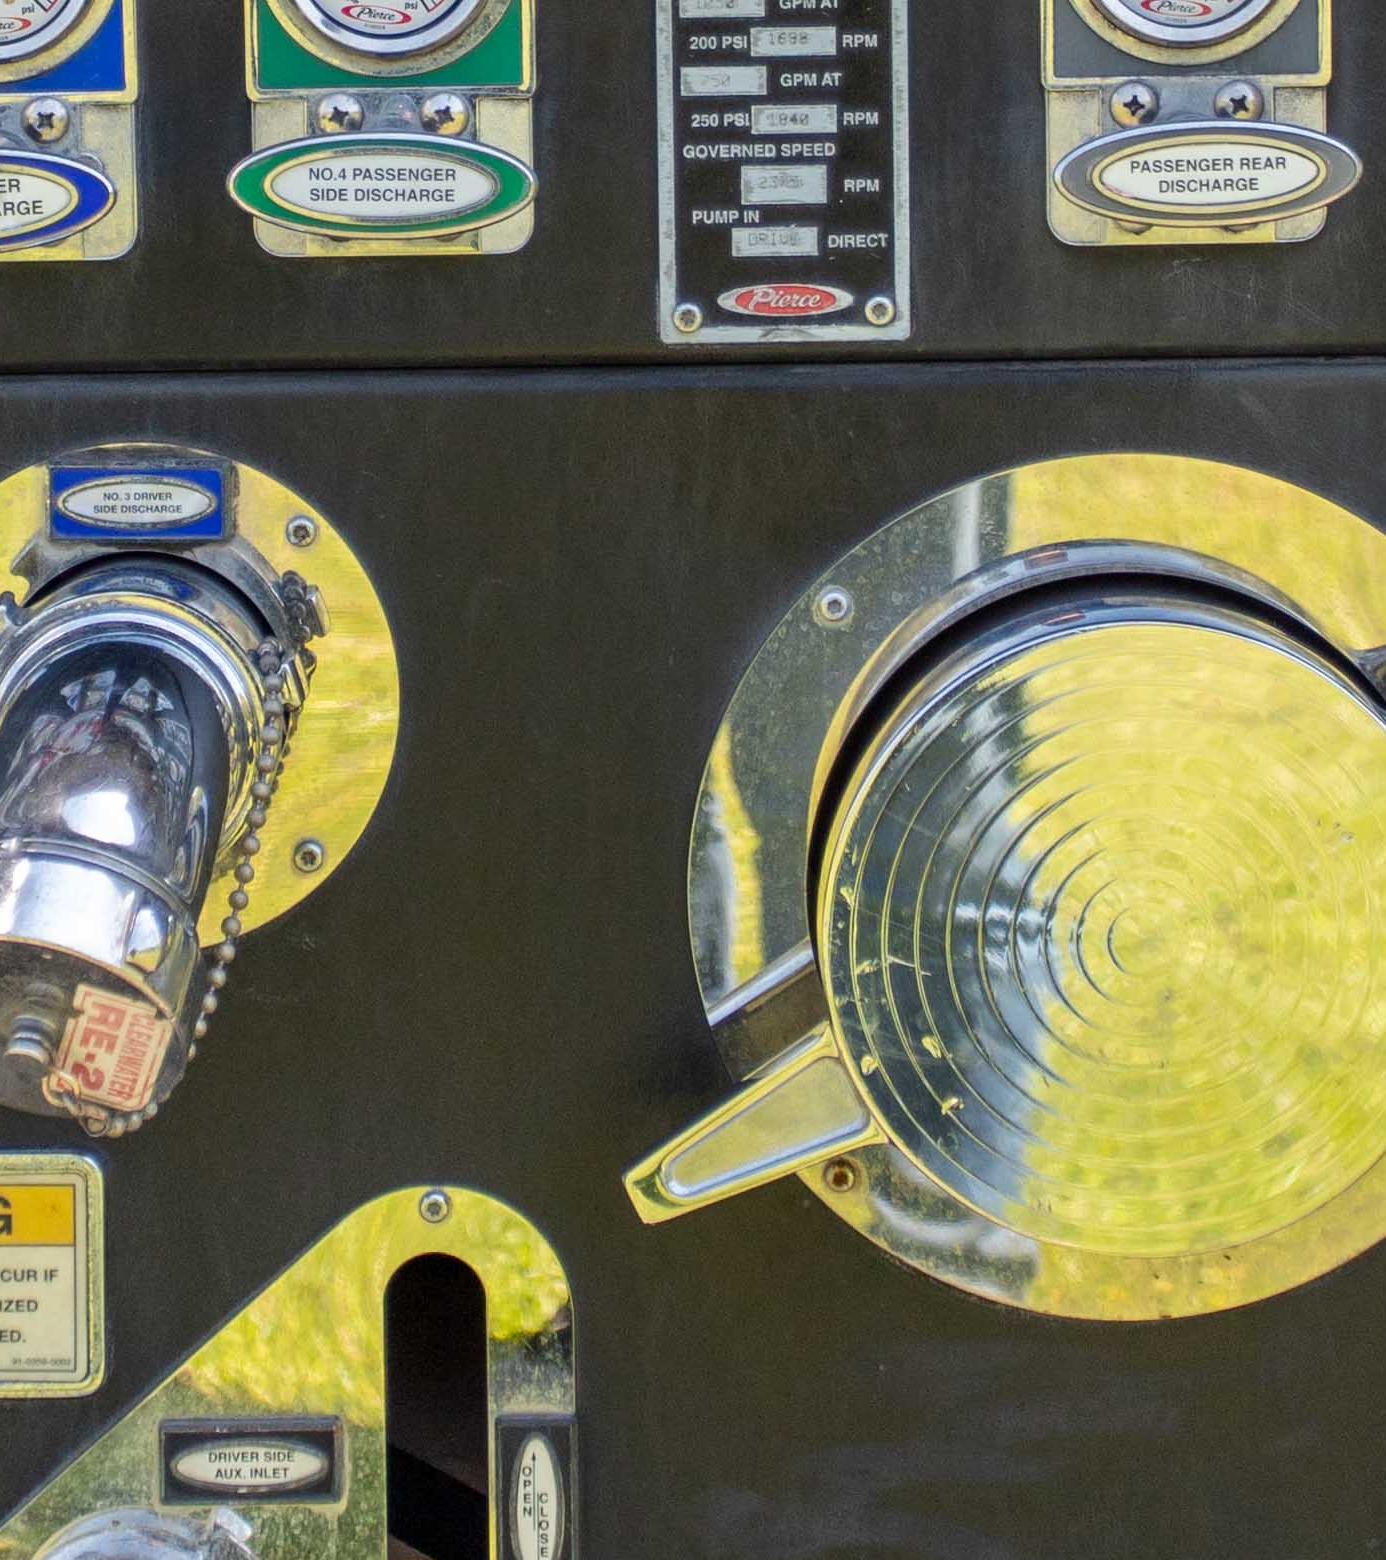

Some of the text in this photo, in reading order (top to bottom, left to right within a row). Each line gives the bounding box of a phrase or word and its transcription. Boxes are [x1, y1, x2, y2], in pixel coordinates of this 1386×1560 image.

[683, 143, 835, 158] GOVERNED SPEED
[1130, 156, 1286, 173] PASSENGER REAR
[308, 166, 456, 182] NO.4 PASSENGER
[1159, 178, 1259, 192] DISCHARGE
[310, 187, 455, 202] SIDE DISCHARGE
[692, 210, 759, 223] PUMP IN
[828, 234, 888, 248] DIRECT
[749, 288, 820, 311] Pierce
[71, 1003, 127, 1090] RE-2
[109, 1013, 155, 1099] CLEARWATER
[43, 1269, 59, 1282] IF
[208, 1451, 295, 1463] DRIVER SIDE
[215, 1467, 289, 1479] AUX. INLET
